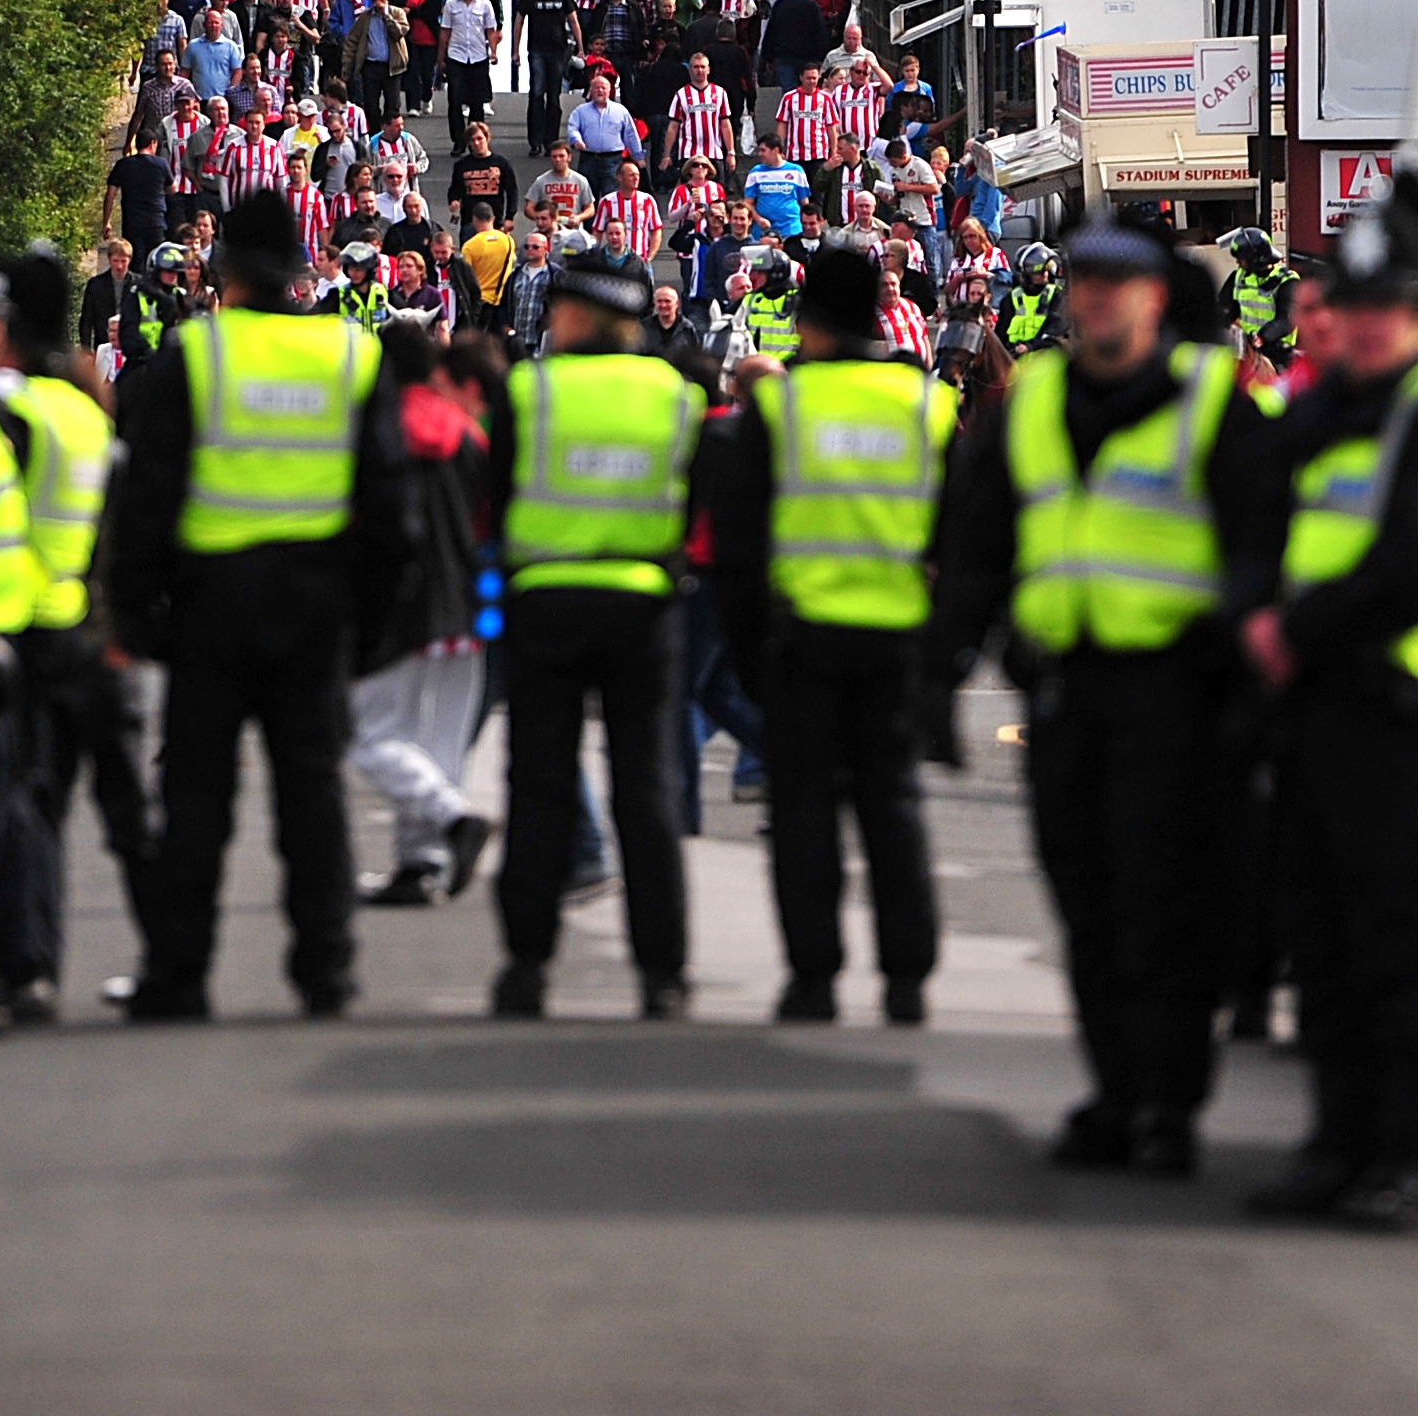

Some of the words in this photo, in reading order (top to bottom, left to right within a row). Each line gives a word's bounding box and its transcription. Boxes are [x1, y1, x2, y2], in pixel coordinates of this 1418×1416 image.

[1114, 74, 1167, 95] CHIPS
[1201, 64, 1252, 110] CAFE
[1116, 170, 1181, 182] STADIUM
[1184, 169, 1250, 181] SUPREME
[545, 183, 579, 194] OSAKA
